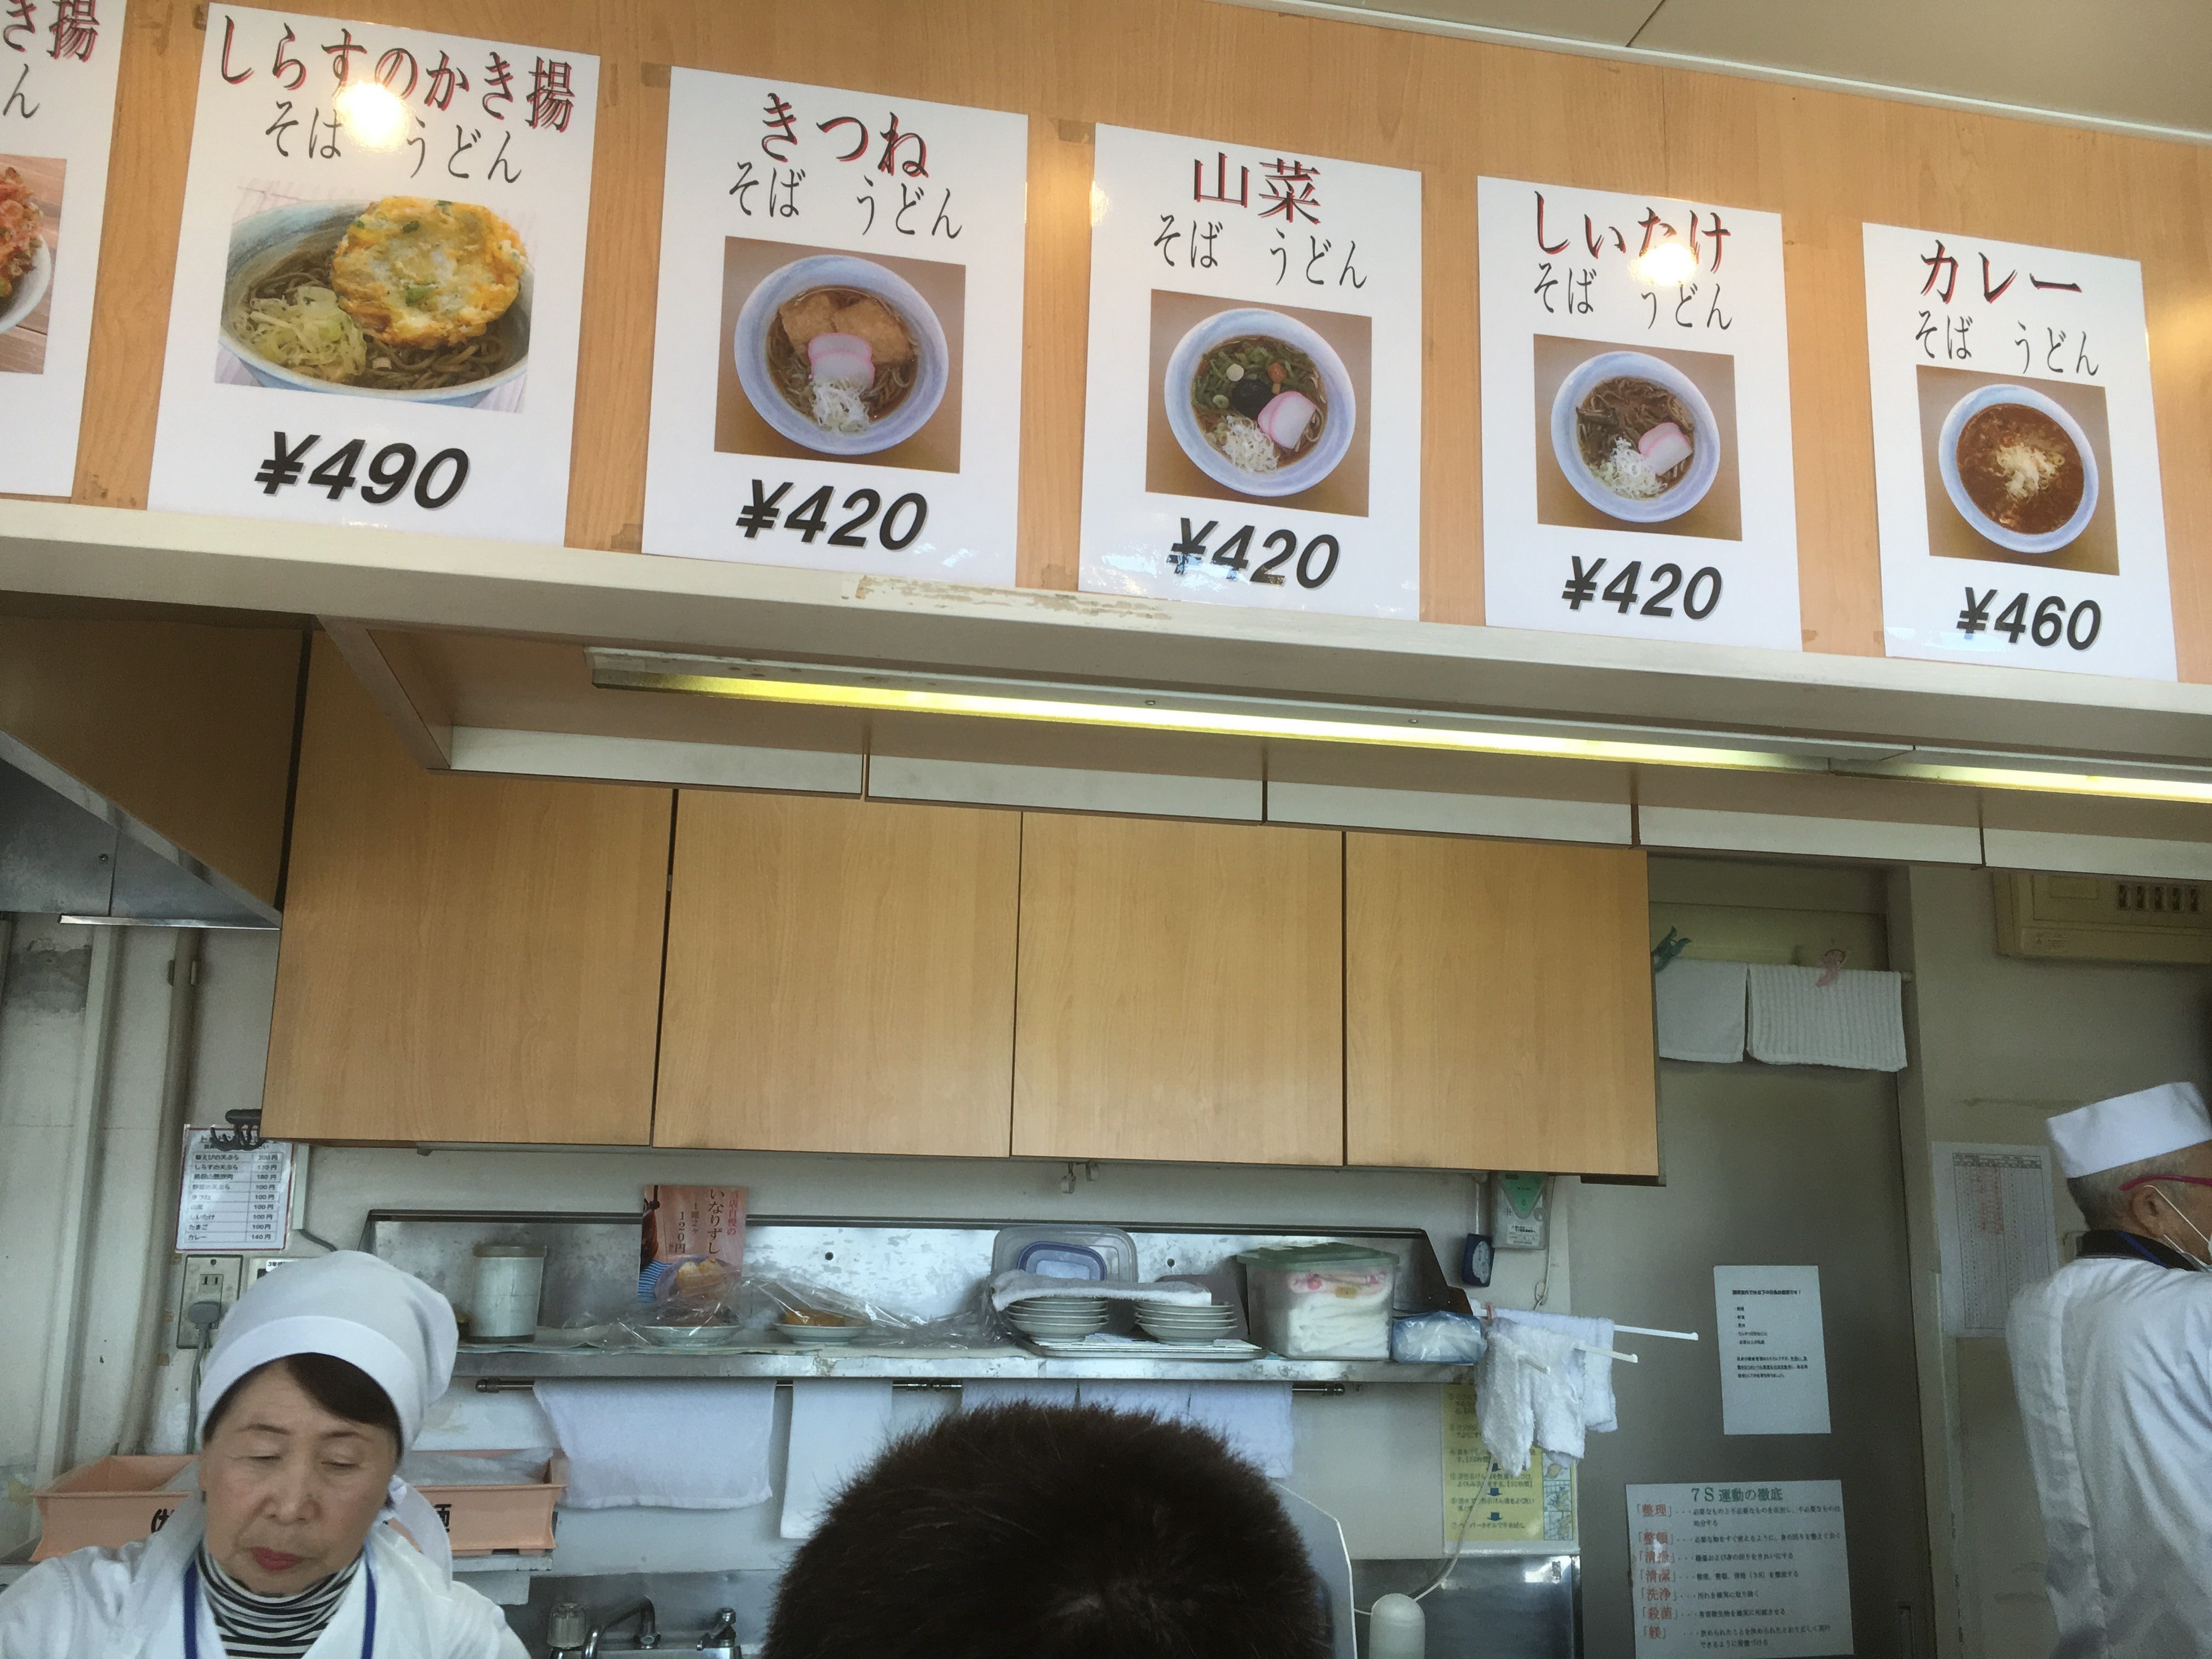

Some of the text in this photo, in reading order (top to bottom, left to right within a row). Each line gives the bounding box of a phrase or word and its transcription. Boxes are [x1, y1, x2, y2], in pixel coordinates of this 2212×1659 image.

[220, 14, 575, 133] しらすのかき揚
[407, 122, 523, 184] うどん
[761, 92, 929, 178] きつね
[729, 161, 962, 240] そば うどん
[1193, 151, 1322, 225] 山菜
[1153, 214, 1368, 290] そば うどん
[1534, 190, 1731, 273] しいたけ
[1534, 262, 1733, 330] そば うどん
[1920, 239, 2083, 304] カレー
[1915, 309, 2100, 377] そば うどん
[254, 430, 472, 512] ¥490
[736, 478, 929, 554] ¥420
[1166, 516, 1341, 590] ¥420
[1561, 555, 1723, 621] ¥420
[1955, 585, 2103, 651] ¥460
[707, 1189, 725, 1255] いなりずし
